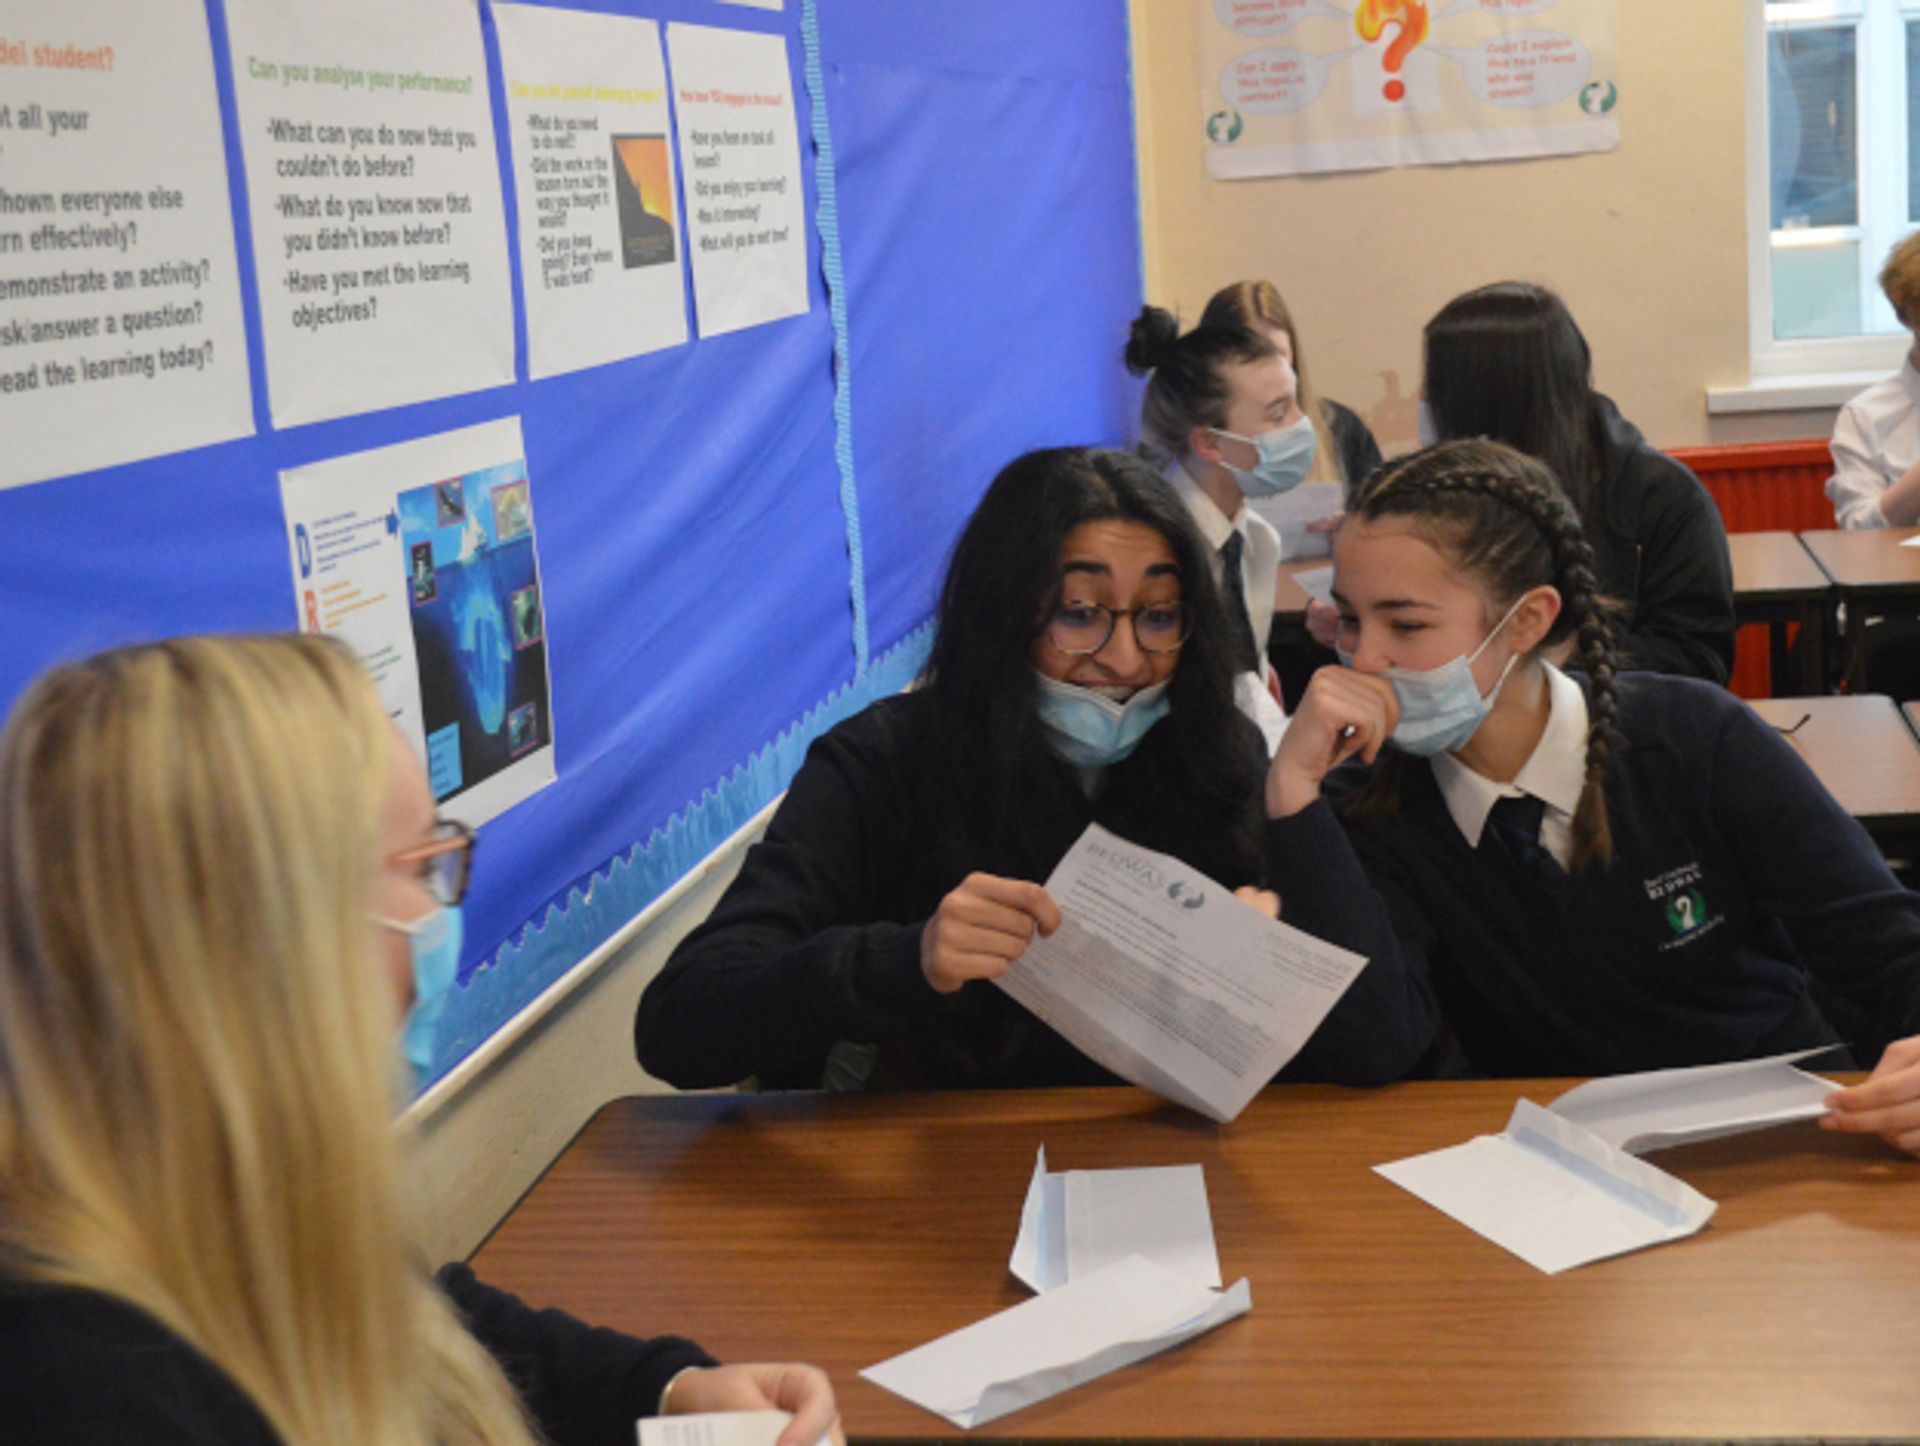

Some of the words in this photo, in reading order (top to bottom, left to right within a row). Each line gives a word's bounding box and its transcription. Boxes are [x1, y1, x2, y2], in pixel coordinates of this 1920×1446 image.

[33, 43, 114, 71] student?
[248, 56, 277, 79] Can
[282, 64, 308, 86] you
[18, 104, 42, 130] all
[47, 110, 89, 136] your
[317, 126, 345, 145] can
[349, 127, 374, 150] you
[378, 123, 395, 146] do
[398, 128, 425, 146] now
[428, 126, 453, 147] that
[456, 131, 477, 151] you
[276, 154, 339, 177] couldn't
[342, 155, 361, 177] do
[364, 154, 414, 177] before?
[61, 191, 143, 216] everyone
[148, 185, 184, 209] else
[326, 194, 344, 217] do
[349, 199, 374, 222] you
[376, 193, 414, 215] know
[417, 197, 444, 214] now
[446, 193, 472, 214] that
[30, 221, 137, 252] effectively?
[283, 232, 312, 259] you
[362, 225, 398, 248] know
[113, 270, 134, 290] an
[139, 258, 210, 288] activity?
[333, 271, 358, 296] you
[363, 265, 390, 287] met
[394, 262, 416, 284] the
[418, 259, 470, 285] learning
[105, 315, 118, 334] a
[122, 301, 203, 337] question?
[291, 296, 377, 332] objectives?
[43, 360, 76, 386] the
[80, 353, 155, 379] learning
[159, 340, 213, 370] today?
